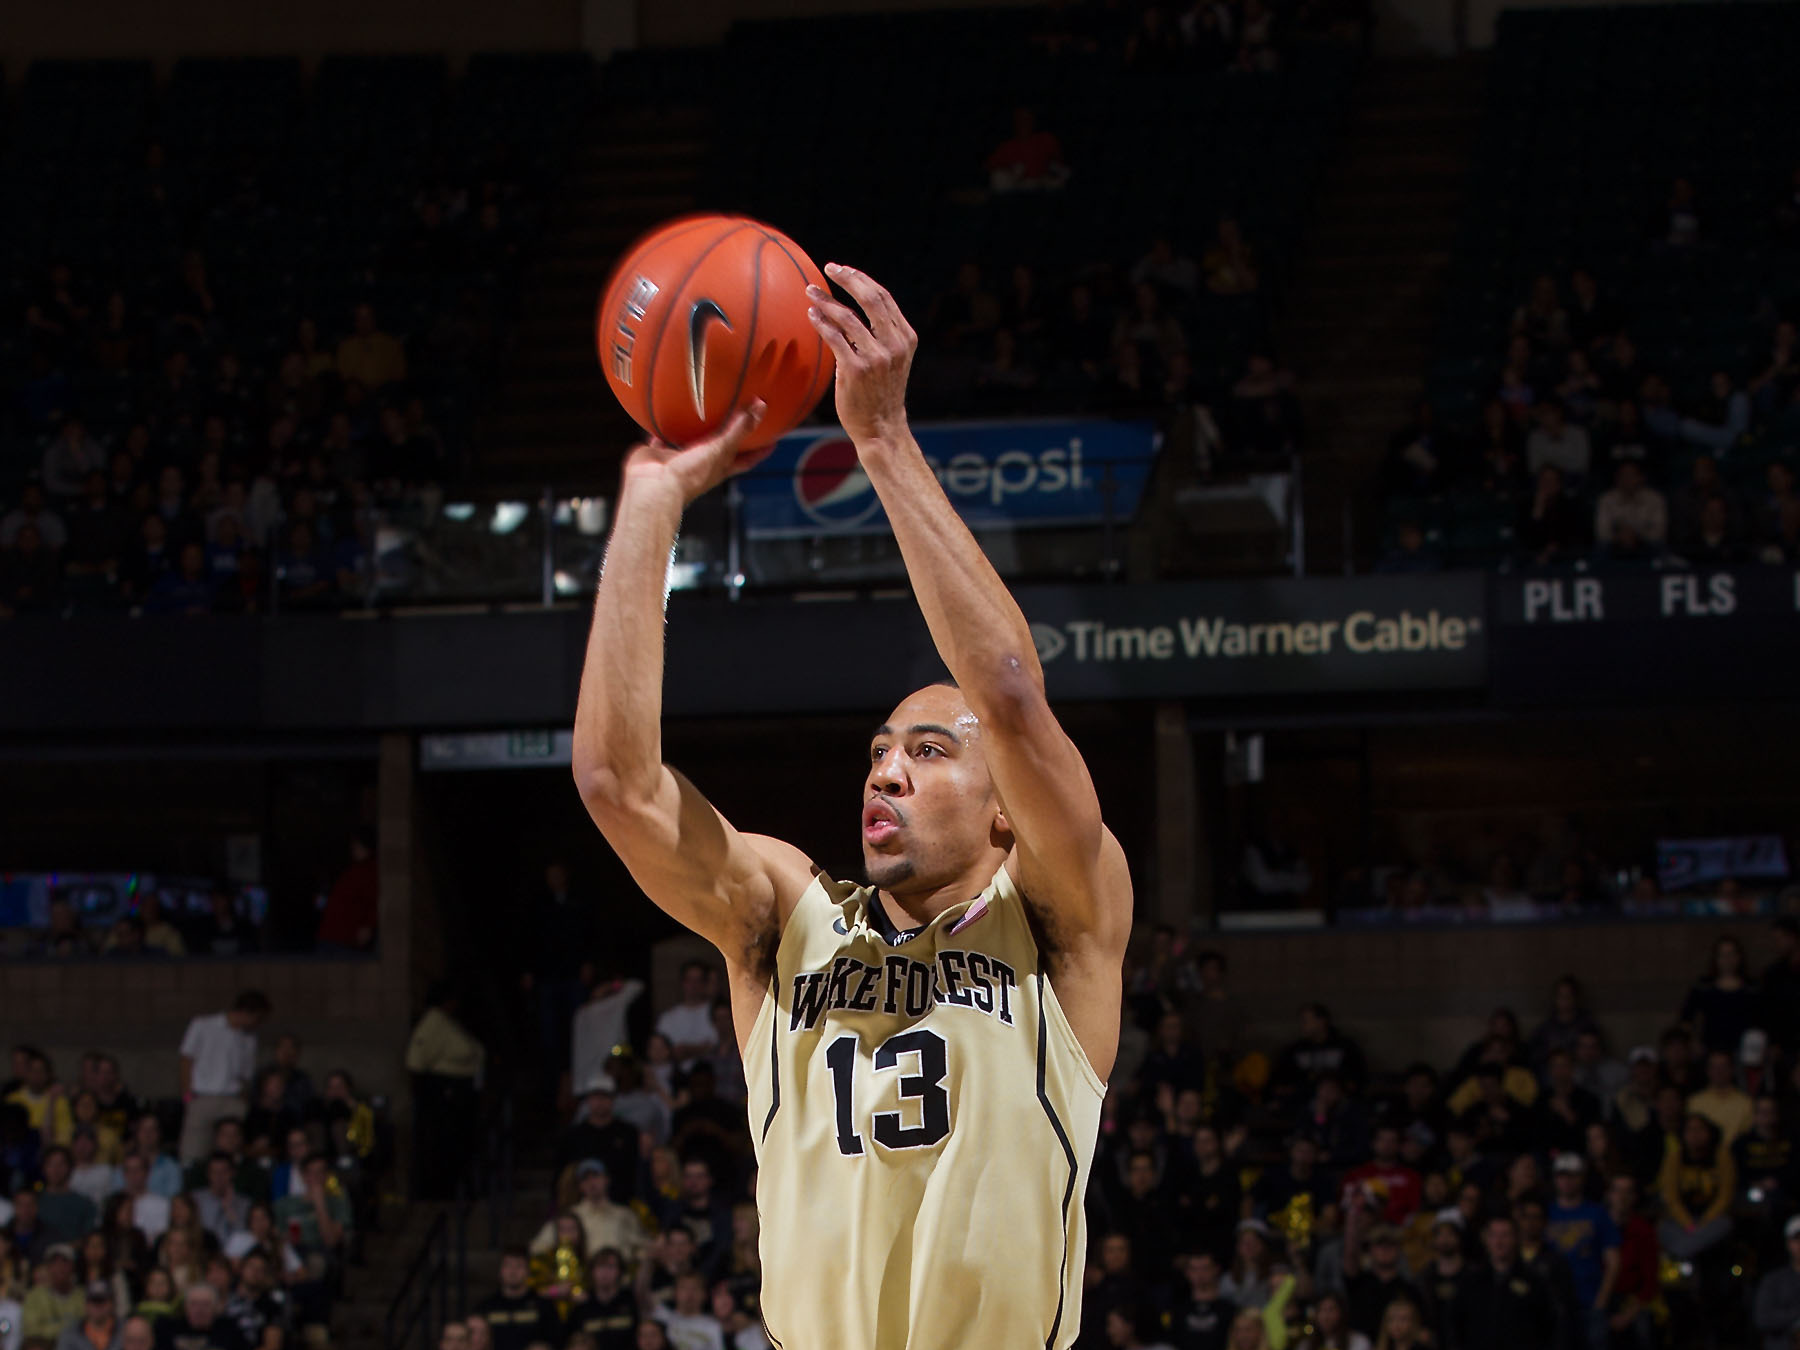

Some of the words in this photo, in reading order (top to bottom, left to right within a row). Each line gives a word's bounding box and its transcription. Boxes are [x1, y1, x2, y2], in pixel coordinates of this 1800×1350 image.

[931, 436, 1084, 505] epsi
[1524, 579, 1603, 622] PLR
[1661, 573, 1737, 616] FLS
[1066, 621, 1174, 661] Time
[1179, 617, 1338, 657] Warner
[1344, 610, 1468, 653] Cable
[789, 956, 883, 1032] WKE
[825, 1028, 951, 1158] 13
